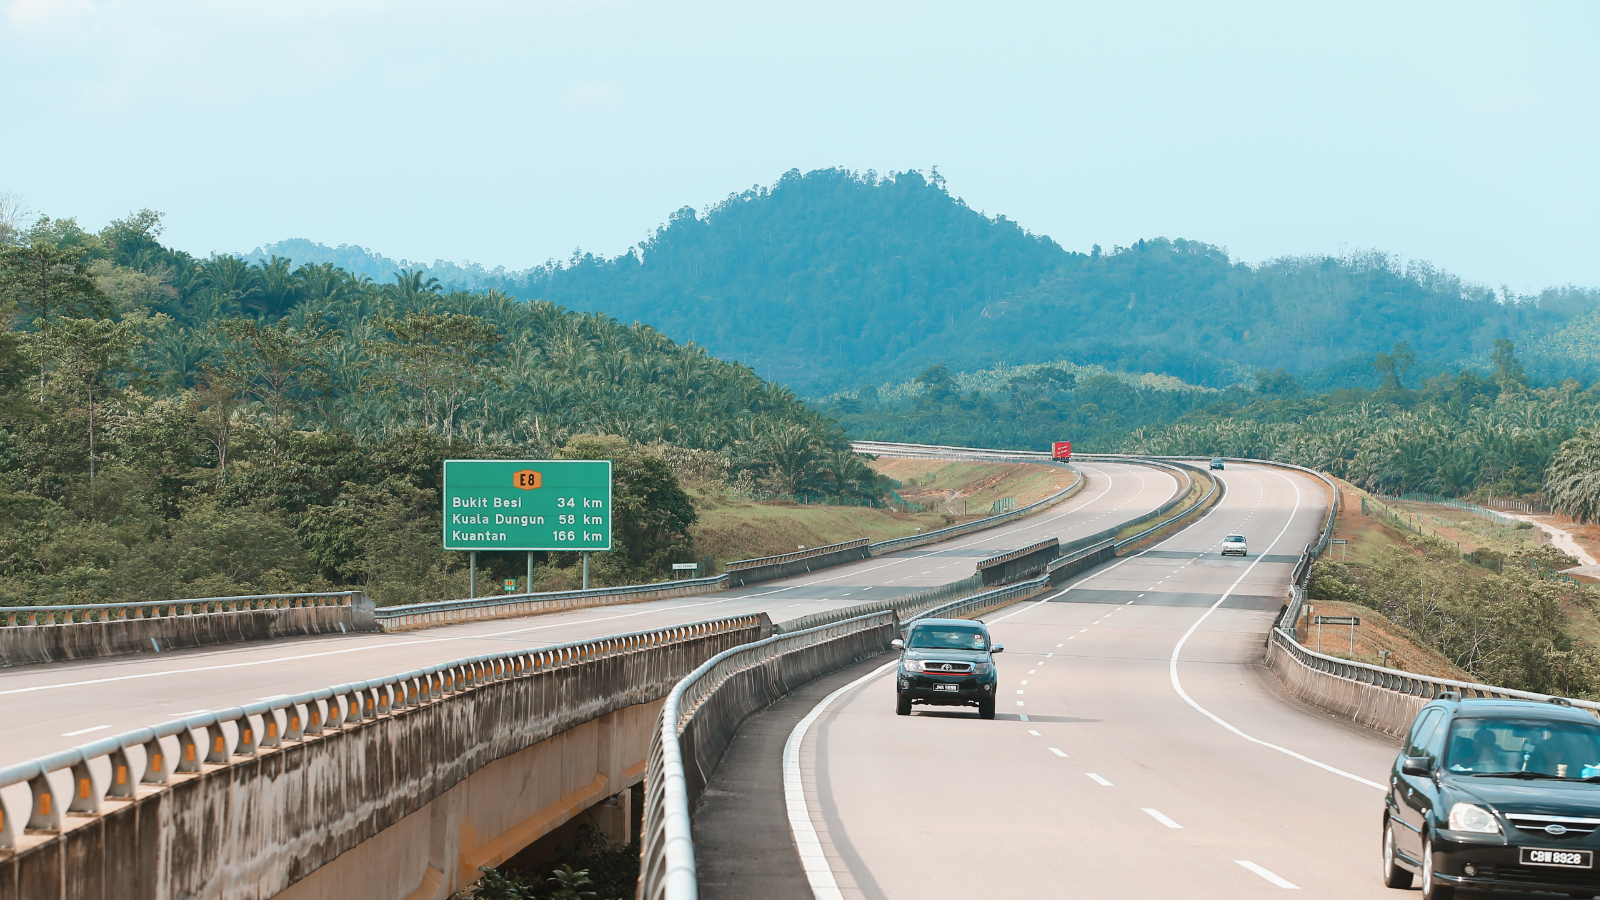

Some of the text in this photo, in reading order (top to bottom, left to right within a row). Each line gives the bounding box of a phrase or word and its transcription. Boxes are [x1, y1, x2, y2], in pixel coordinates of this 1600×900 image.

[520, 474, 535, 486] E8
[452, 497, 603, 508] Bukit Besi 34 km
[452, 514, 603, 527] Kuala Dungun 58 km
[452, 530, 603, 541] Kuantan 166 km
